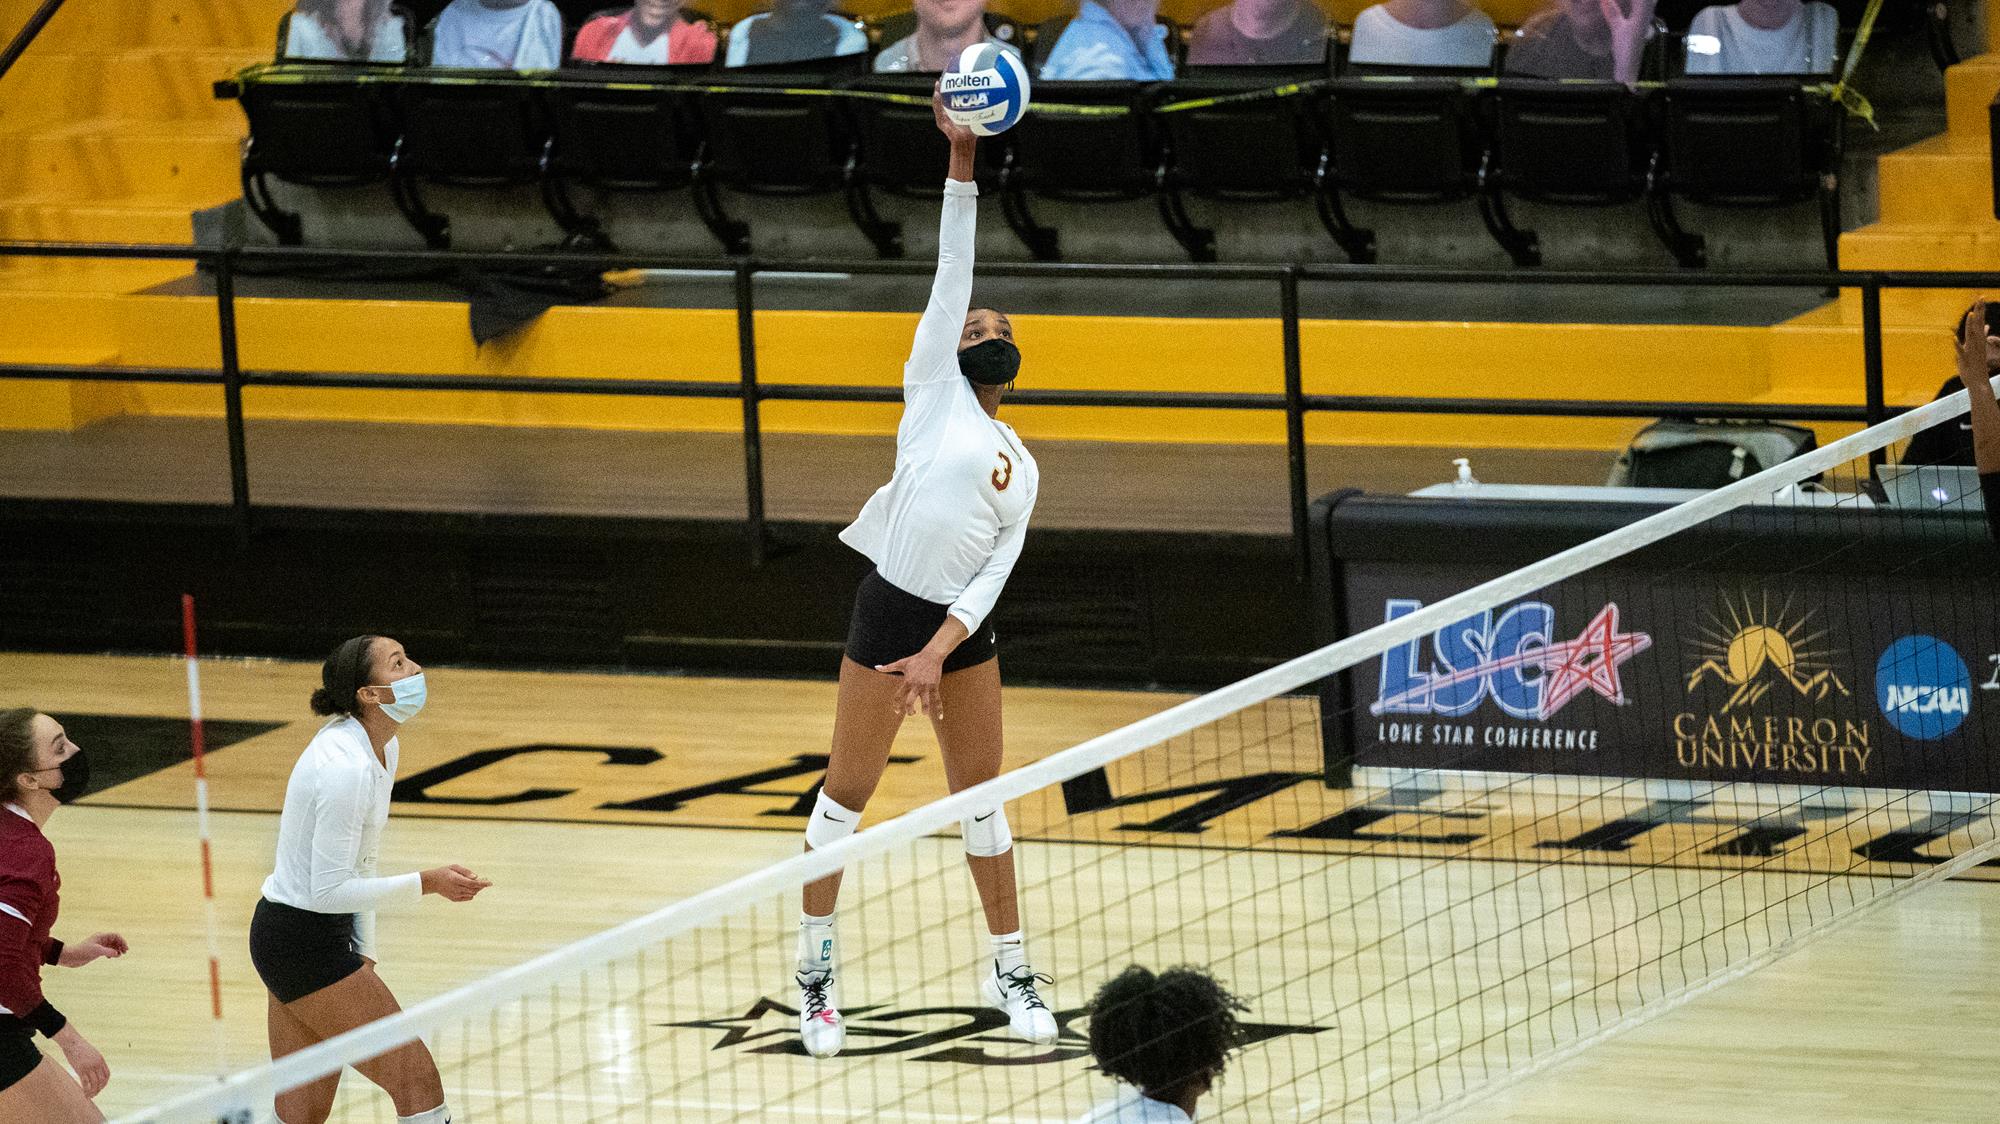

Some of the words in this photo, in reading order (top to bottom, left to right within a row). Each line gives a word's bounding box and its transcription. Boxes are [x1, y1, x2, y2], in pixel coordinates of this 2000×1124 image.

[946, 75, 991, 89] molten
[951, 92, 988, 108] NCAA
[991, 451, 1012, 491] 3
[1376, 598, 1555, 719] LSC
[1886, 684, 1969, 715] NCAA
[1378, 722, 1424, 744] LONE
[1433, 724, 1475, 745] STAR
[1484, 726, 1599, 750] CONFERENCE
[1673, 712, 1868, 747] CAMERON
[1677, 736, 1873, 775] UNIVERSITY
